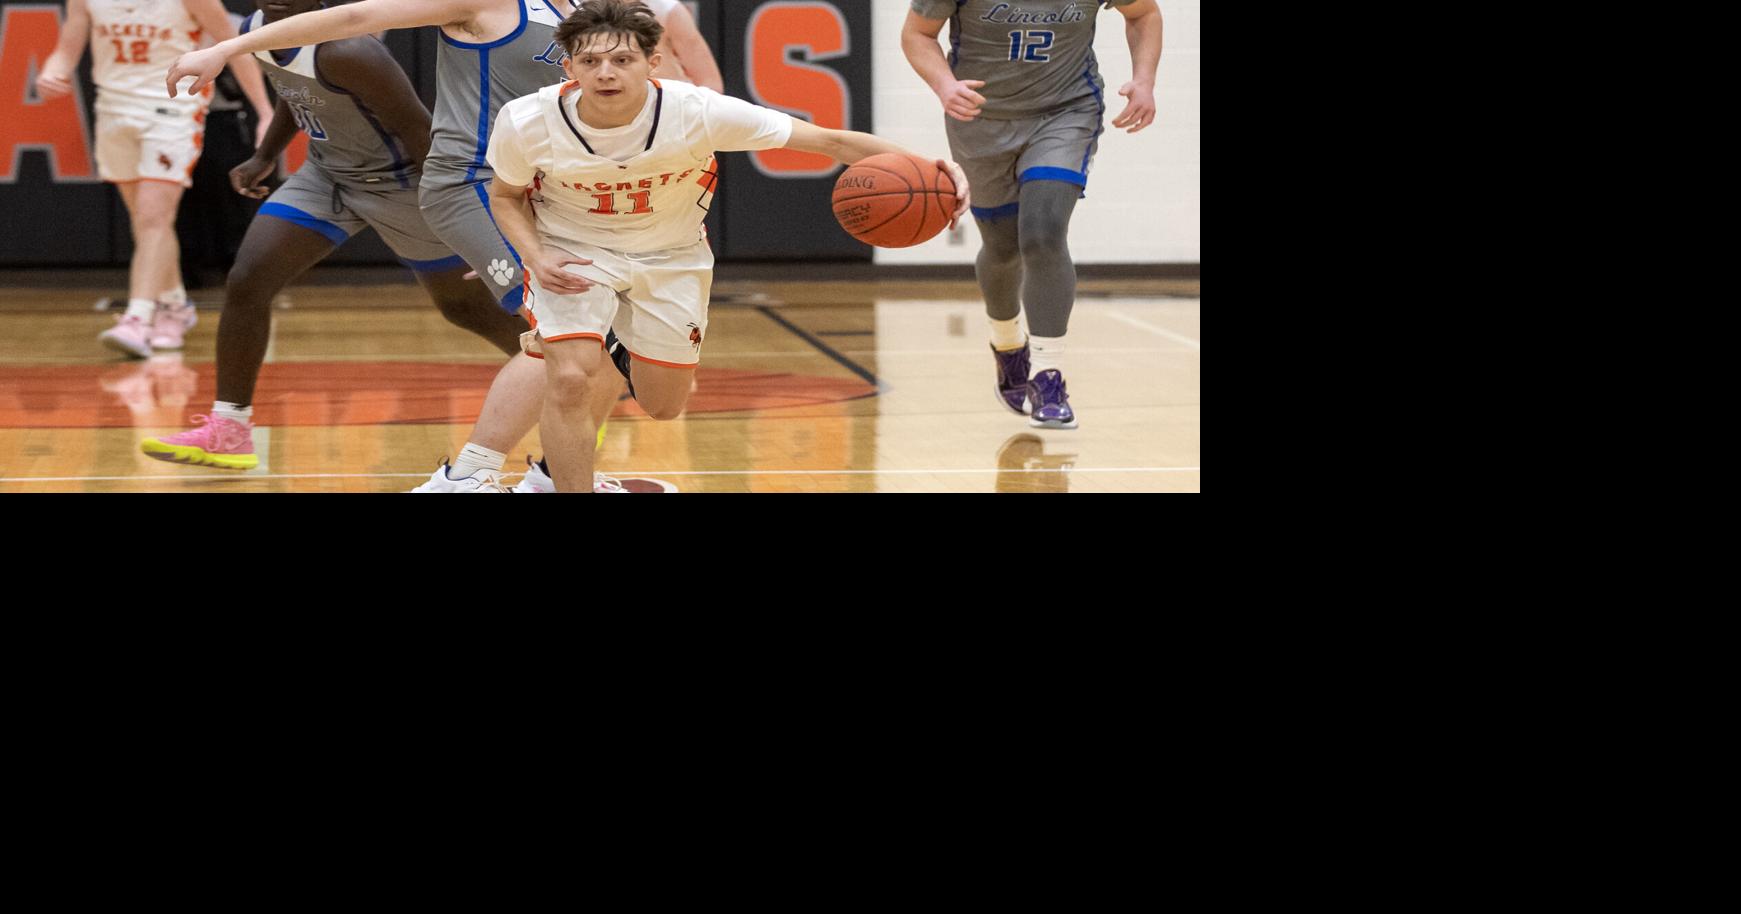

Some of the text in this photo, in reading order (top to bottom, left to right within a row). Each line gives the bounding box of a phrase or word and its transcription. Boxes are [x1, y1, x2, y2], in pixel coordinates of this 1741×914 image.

[981, 2, 1085, 24] Lincoln
[111, 38, 150, 64] 12
[1008, 30, 1054, 62] 12
[587, 190, 653, 215] 11
